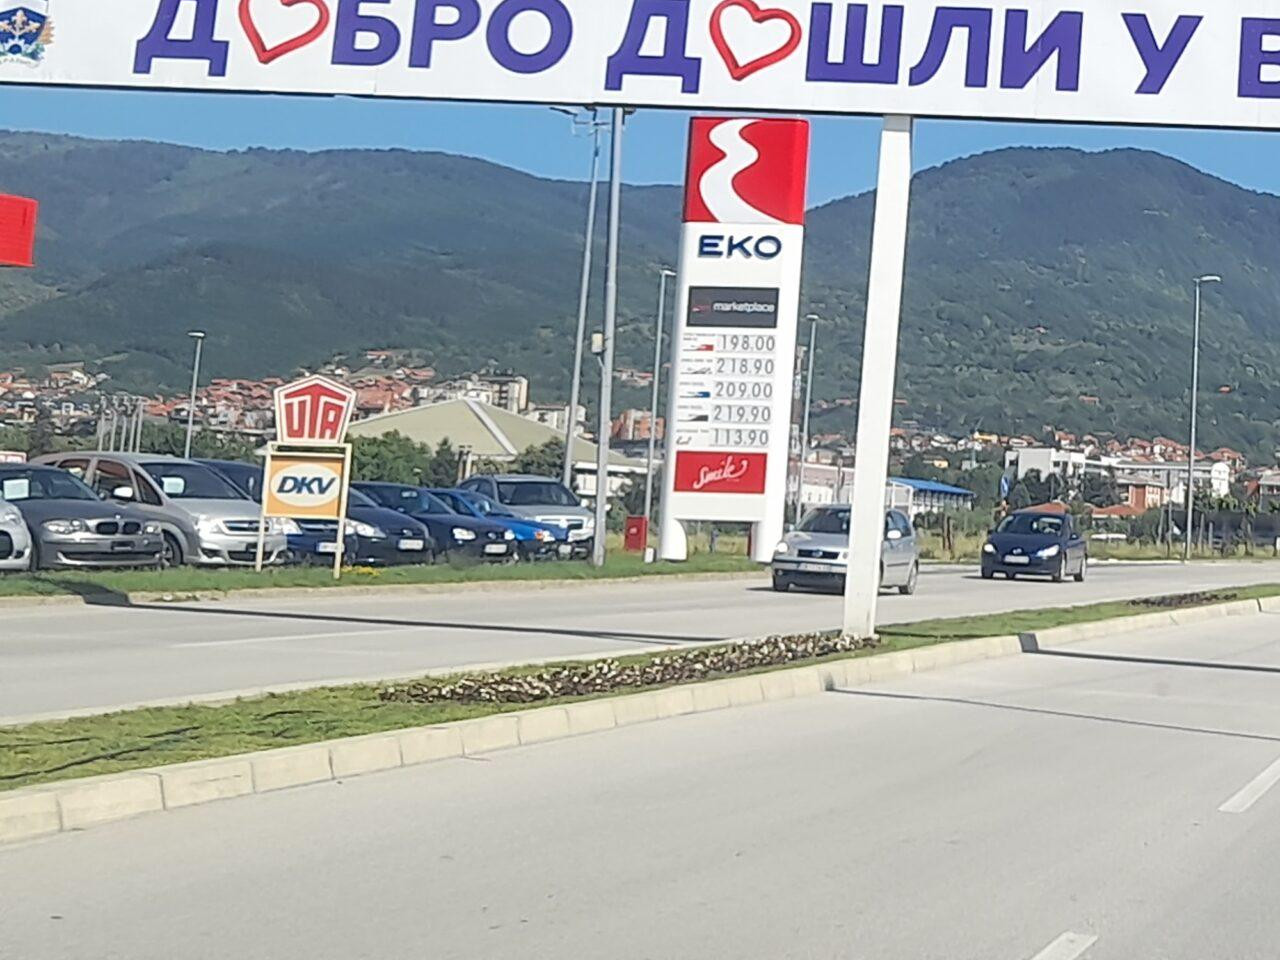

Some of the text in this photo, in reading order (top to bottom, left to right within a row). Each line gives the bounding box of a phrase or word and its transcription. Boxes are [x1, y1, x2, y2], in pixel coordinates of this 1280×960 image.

[1121, 13, 1203, 95] У
[698, 235, 782, 260] EKO
[713, 301, 775, 314] marketplace
[721, 334, 776, 352] 198.00
[716, 358, 775, 375] 218.90
[715, 381, 773, 399] 209.00
[284, 384, 347, 438] UTA
[713, 404, 771, 422] 219.90
[714, 428, 769, 446] 113.90
[693, 455, 748, 489] Smile
[277, 476, 336, 495] DKV
